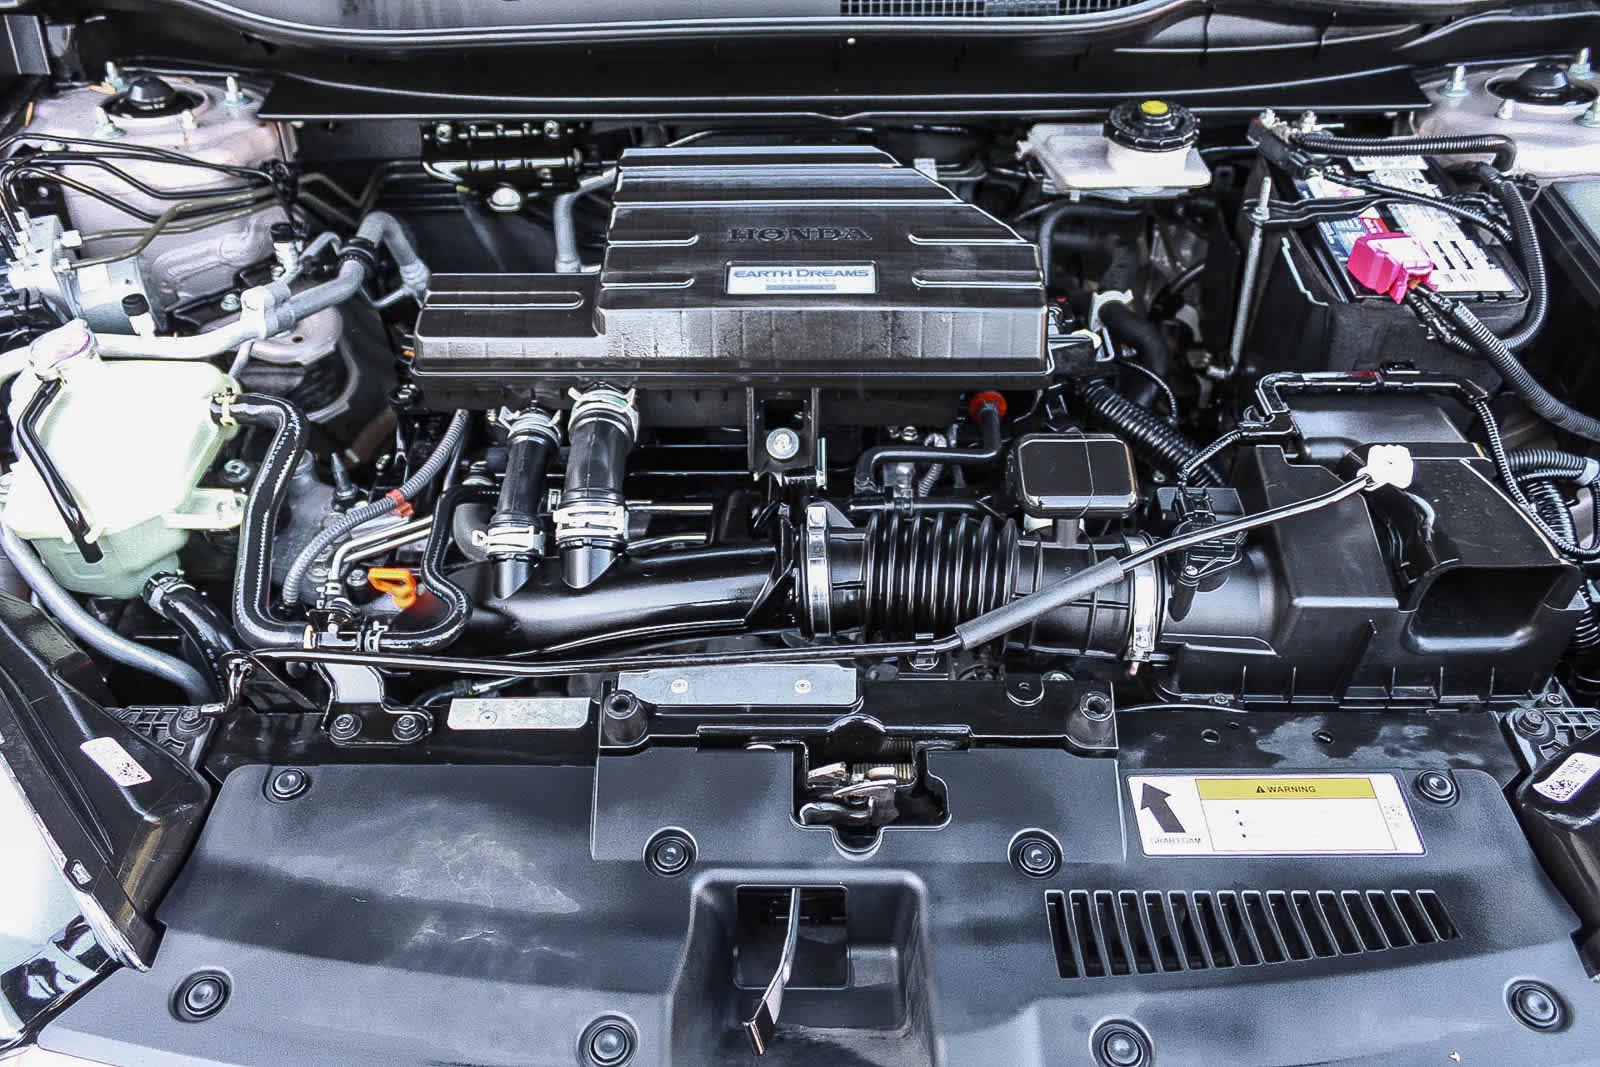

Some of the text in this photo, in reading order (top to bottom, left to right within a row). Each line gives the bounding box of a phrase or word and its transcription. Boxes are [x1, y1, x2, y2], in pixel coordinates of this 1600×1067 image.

[727, 226, 873, 242] HONDA
[733, 268, 869, 278] EARTH DREAMS
[1266, 785, 1317, 793] WARNING
